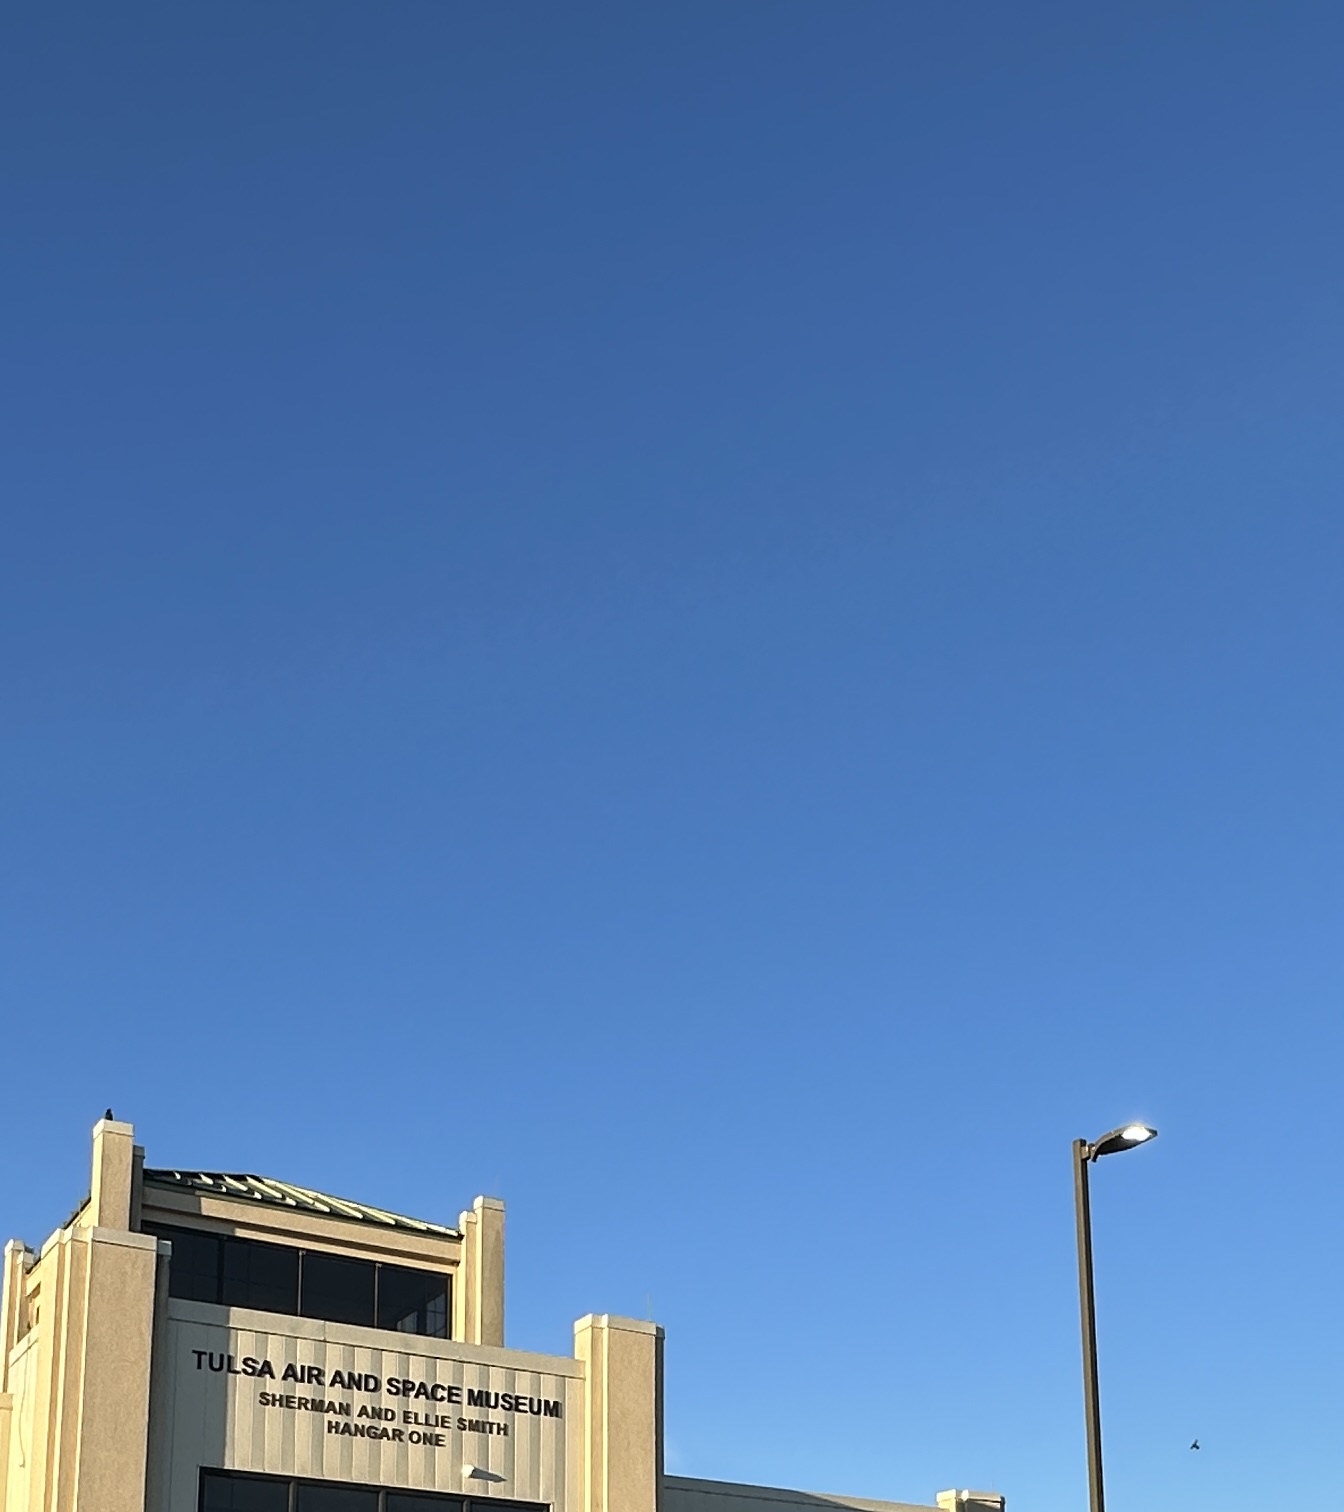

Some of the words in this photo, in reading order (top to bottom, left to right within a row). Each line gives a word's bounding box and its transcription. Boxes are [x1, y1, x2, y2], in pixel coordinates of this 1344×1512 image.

[192, 1349, 276, 1380] TULSA
[281, 1362, 325, 1387] AIR
[329, 1369, 382, 1394] AND
[386, 1377, 461, 1405] SPACE
[467, 1388, 563, 1419] MUSEUM
[258, 1391, 351, 1417] SHERMAN
[357, 1404, 397, 1423] AND
[402, 1410, 451, 1429] ELLIE
[456, 1417, 510, 1437] SMITH
[326, 1419, 404, 1443] HANGAR
[408, 1430, 446, 1448] ONE
